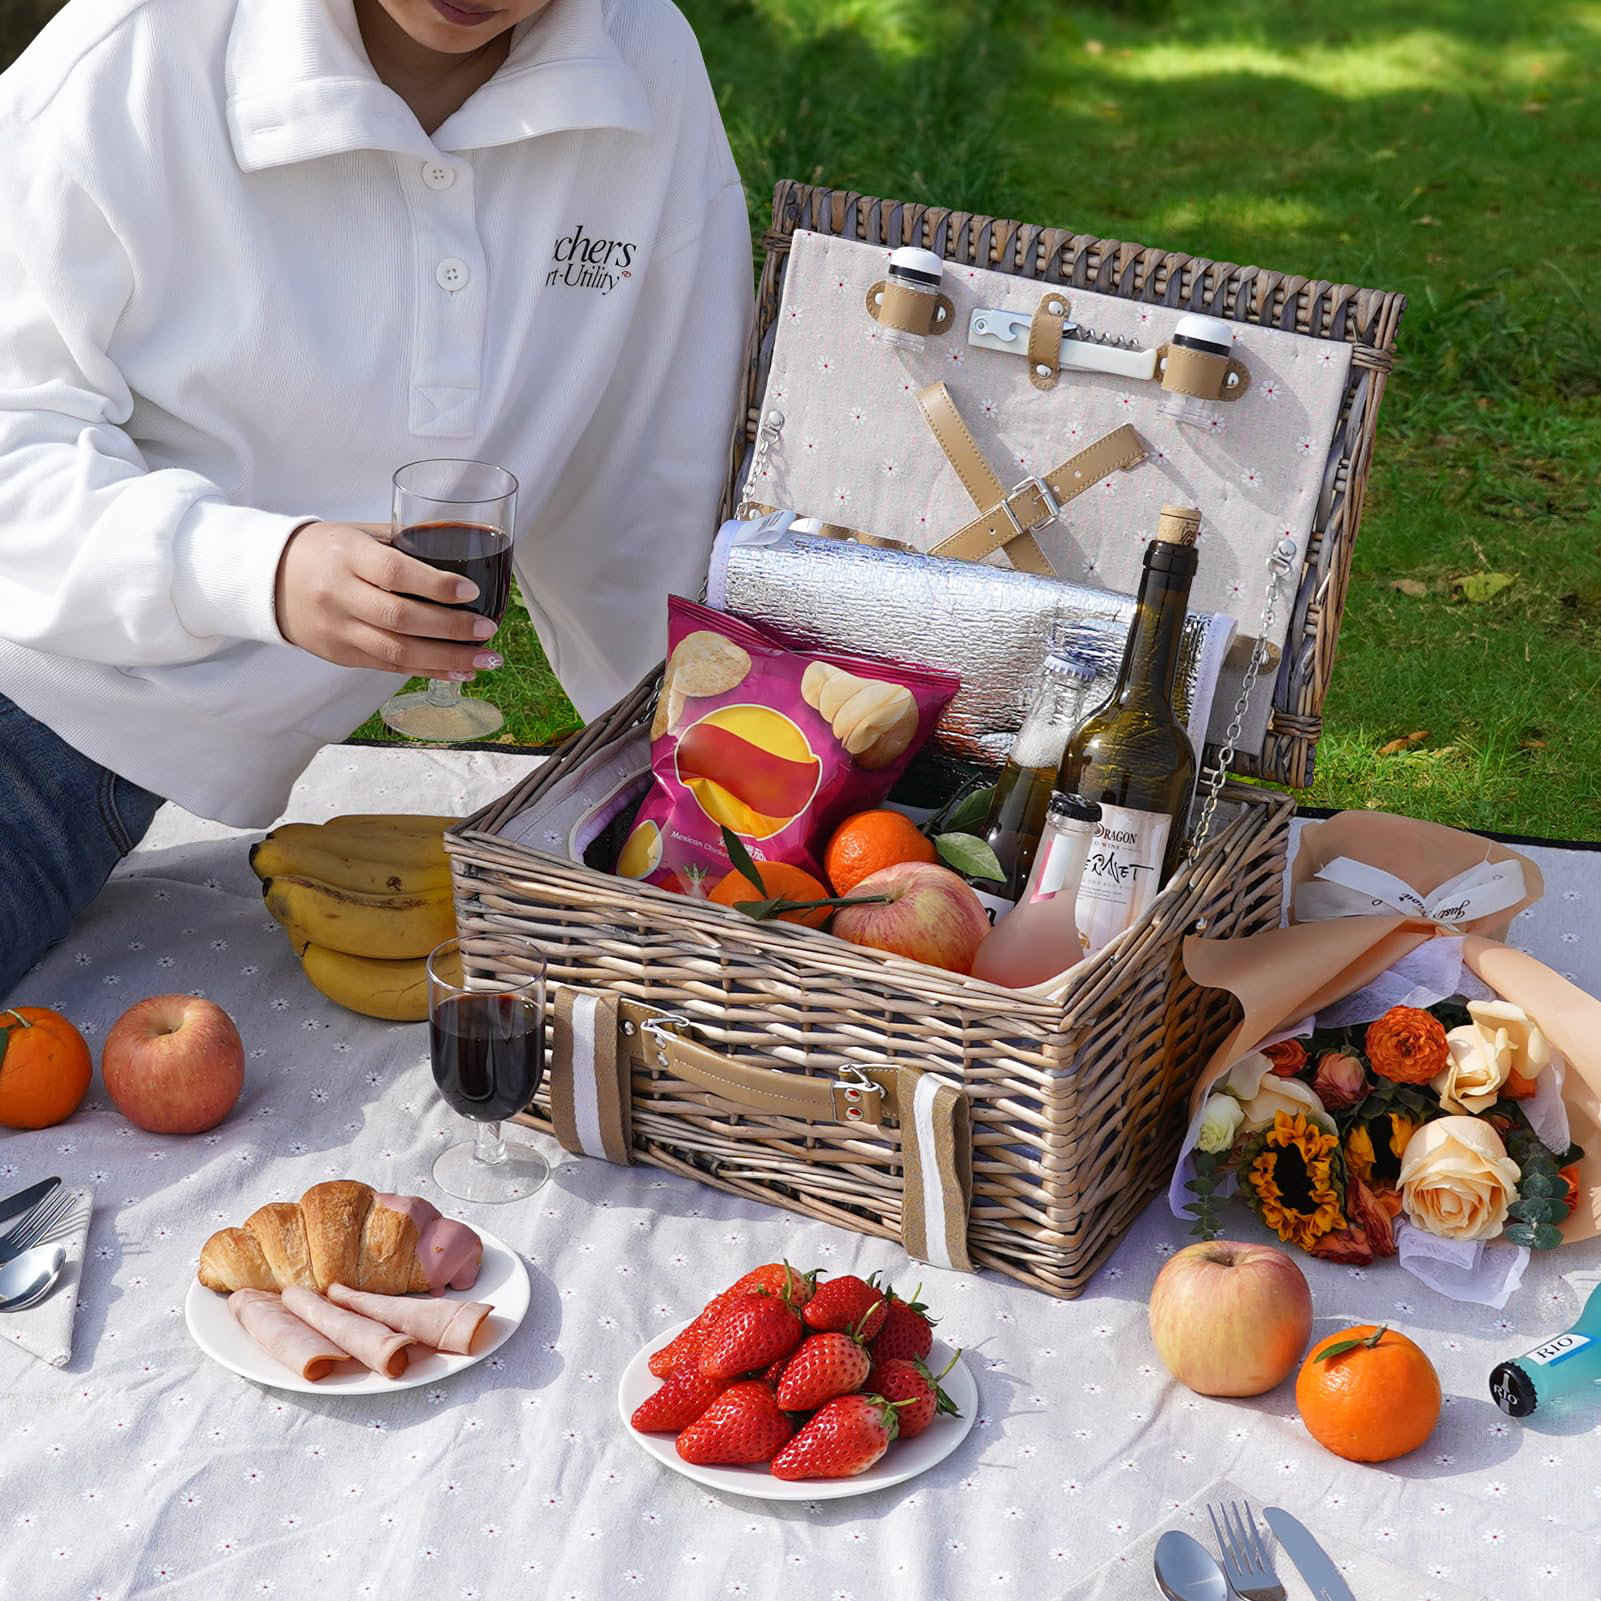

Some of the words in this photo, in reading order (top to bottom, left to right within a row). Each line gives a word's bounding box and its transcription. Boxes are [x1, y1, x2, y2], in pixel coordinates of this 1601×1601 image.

[552, 225, 637, 268] chers
[671, 831, 703, 848] Mexican
[1536, 1337, 1574, 1359] RIO
[1493, 1384, 1518, 1405] RIO
